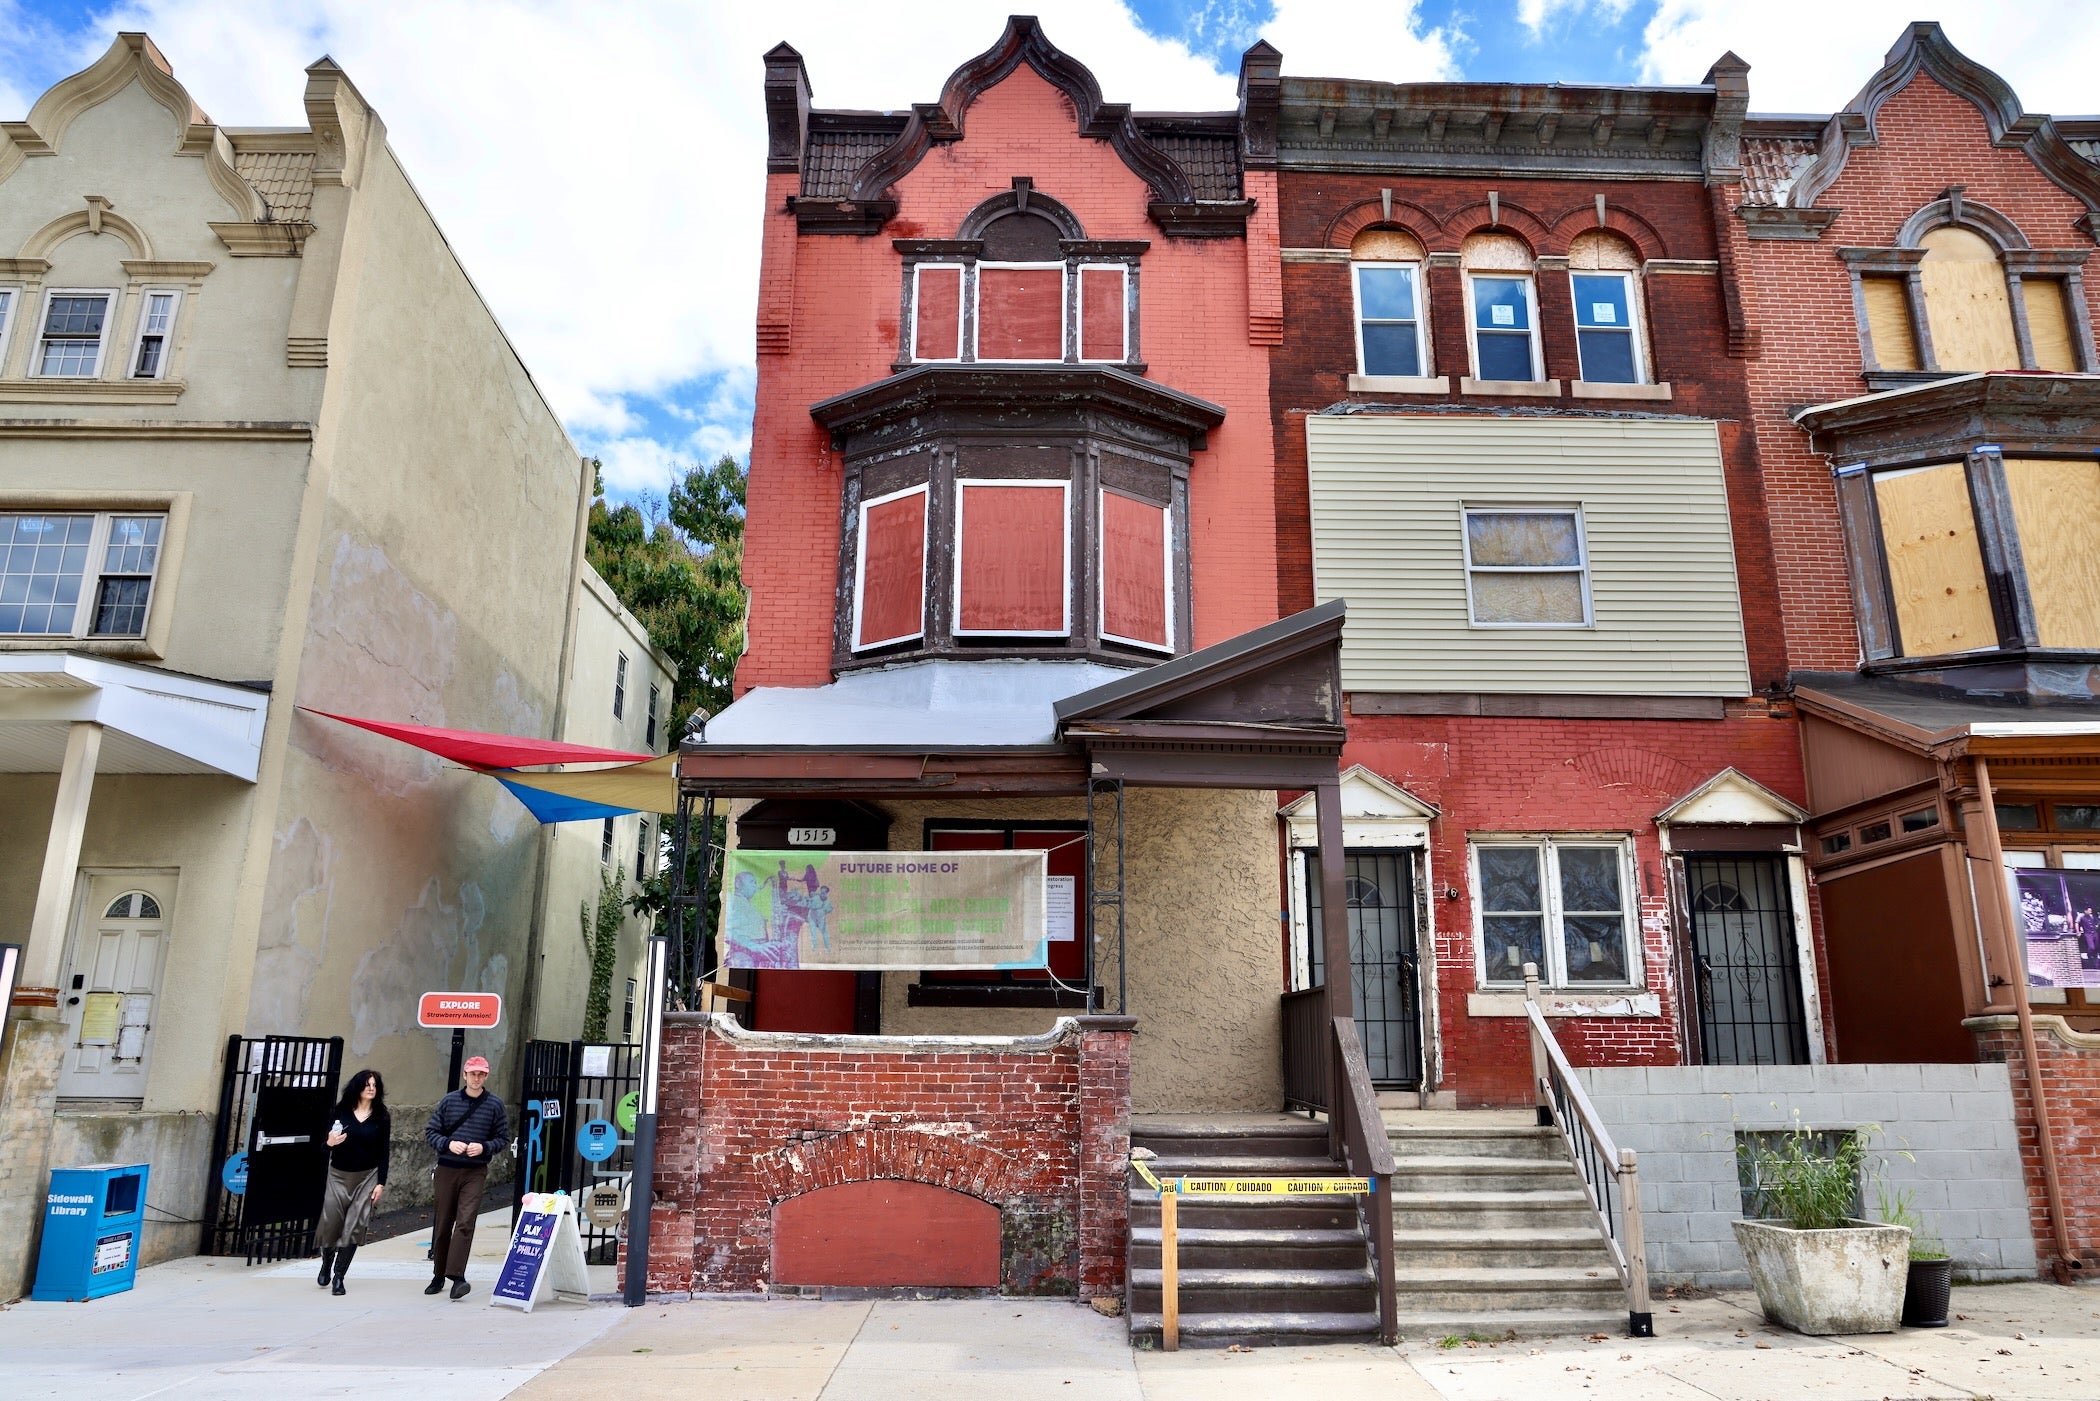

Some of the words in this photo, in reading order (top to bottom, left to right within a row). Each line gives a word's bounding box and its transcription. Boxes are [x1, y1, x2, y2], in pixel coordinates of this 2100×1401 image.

[796, 829, 829, 841] 1515
[840, 863, 893, 873] FUTURE
[897, 863, 937, 873] HOME
[940, 863, 959, 873] OF
[930, 897, 961, 913] ARTS
[964, 897, 1010, 913] CENTER
[860, 919, 893, 934] JOHN
[961, 918, 1005, 933] STREET
[440, 1001, 480, 1009] EXPLORE
[544, 1101, 559, 1117] OPEN
[1190, 1182, 1226, 1191] CAUTION
[1236, 1182, 1272, 1192] CUIDADO
[1287, 1182, 1323, 1191] CAUTION
[1333, 1182, 1368, 1191] CUIDADO
[47, 1194, 94, 1204] Sidewalk
[51, 1206, 87, 1216] Library
[523, 1224, 542, 1236] PLAY
[516, 1245, 541, 1256] PHILLY
